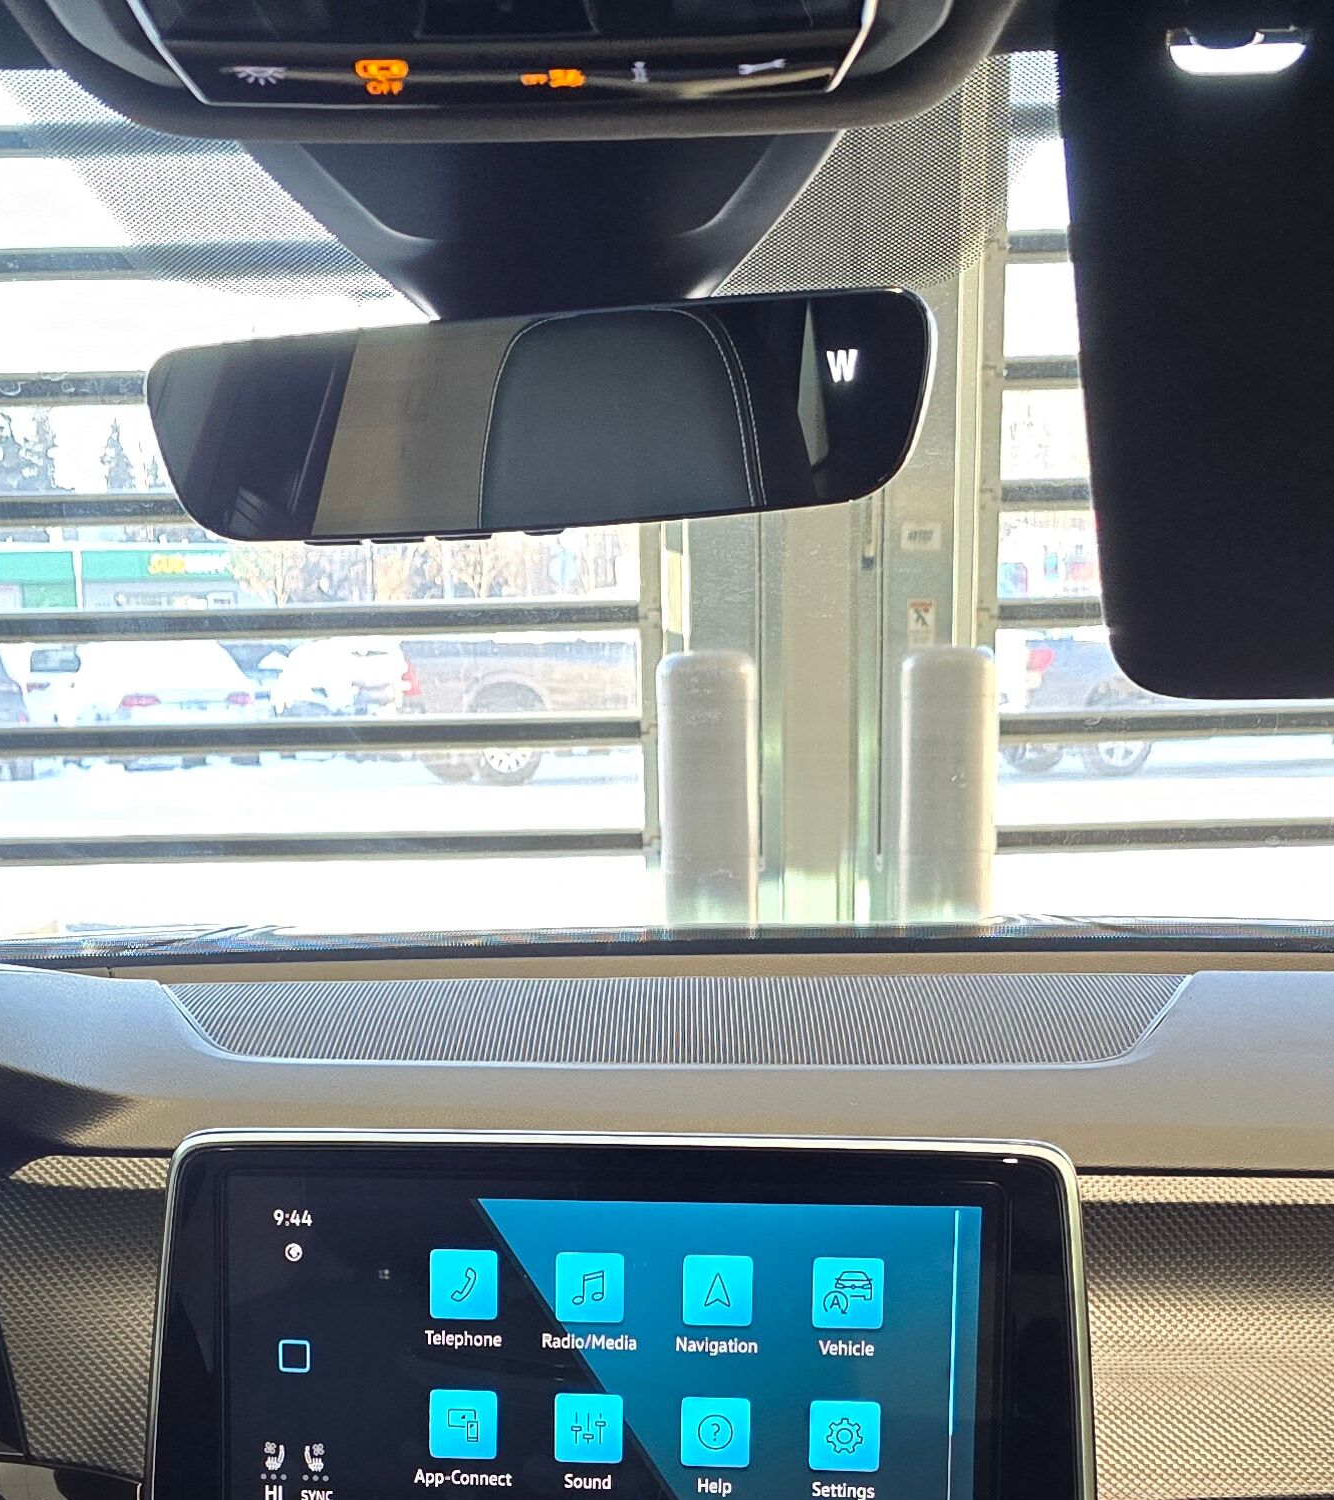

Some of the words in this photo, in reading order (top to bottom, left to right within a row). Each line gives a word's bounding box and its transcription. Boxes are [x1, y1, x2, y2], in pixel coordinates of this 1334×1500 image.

[826, 349, 858, 383] W
[273, 1208, 313, 1227] 9:44
[424, 1330, 503, 1349] Telephone
[541, 1333, 637, 1351] Radio/Media
[675, 1336, 758, 1357] Navigation
[818, 1340, 875, 1357] Vehicle
[414, 1468, 513, 1490] App-Connect
[563, 1474, 612, 1491] Sound
[696, 1477, 733, 1497] Help
[264, 1485, 283, 1500] HI
